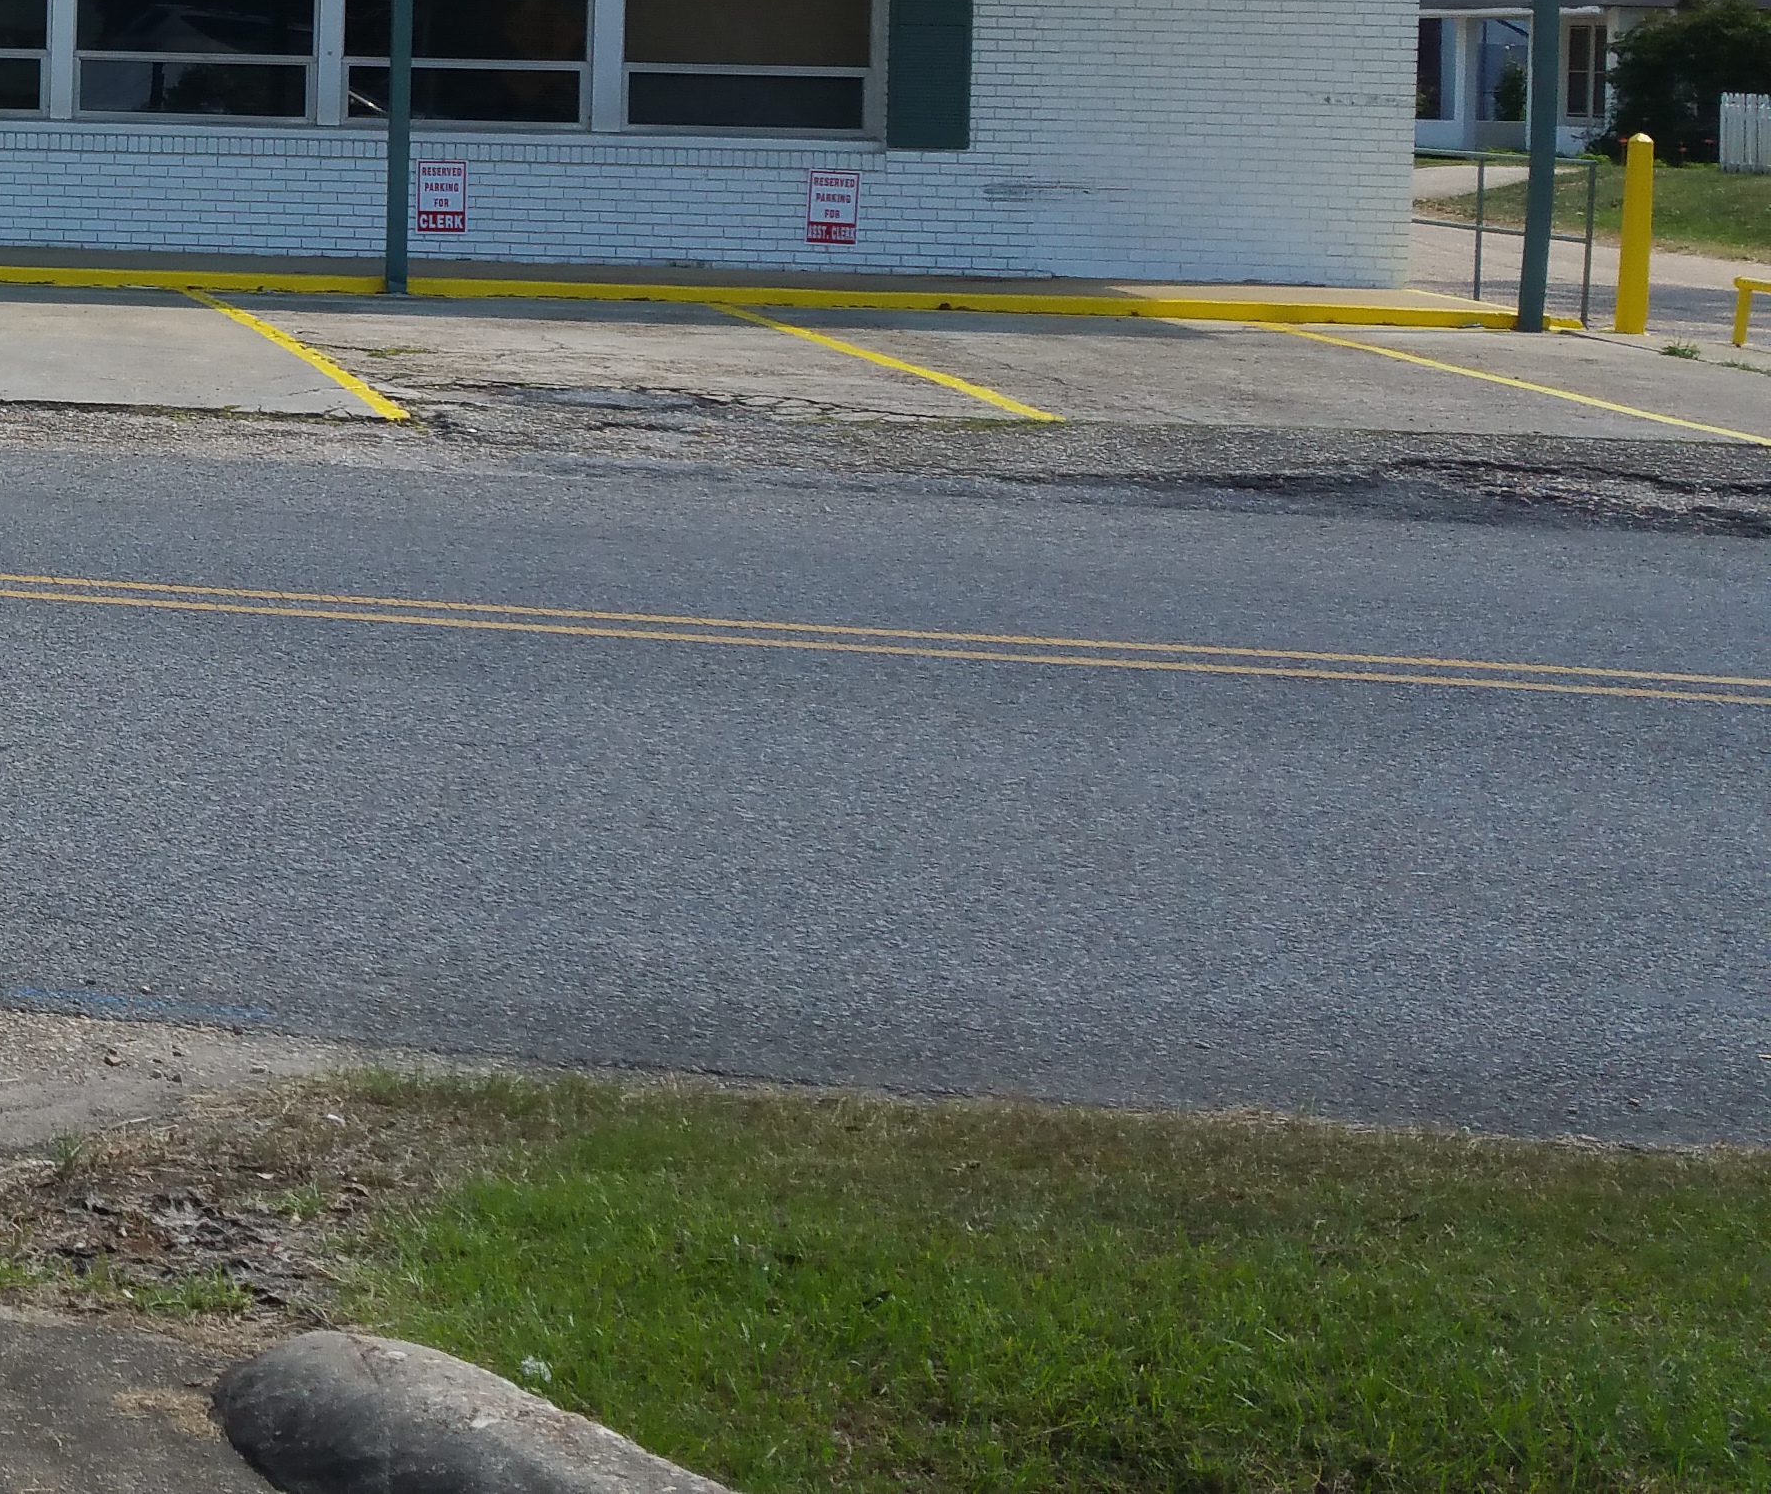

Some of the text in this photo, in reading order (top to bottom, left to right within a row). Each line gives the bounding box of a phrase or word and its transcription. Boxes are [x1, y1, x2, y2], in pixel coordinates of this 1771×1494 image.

[422, 167, 462, 176] RESERVED
[425, 182, 459, 192] PARKING
[814, 177, 855, 188] RESERVED
[434, 198, 449, 207] FOR
[816, 193, 851, 203] PARKING
[825, 209, 840, 218] FOR
[420, 214, 463, 229] CLERK
[831, 226, 856, 240] CLERK
